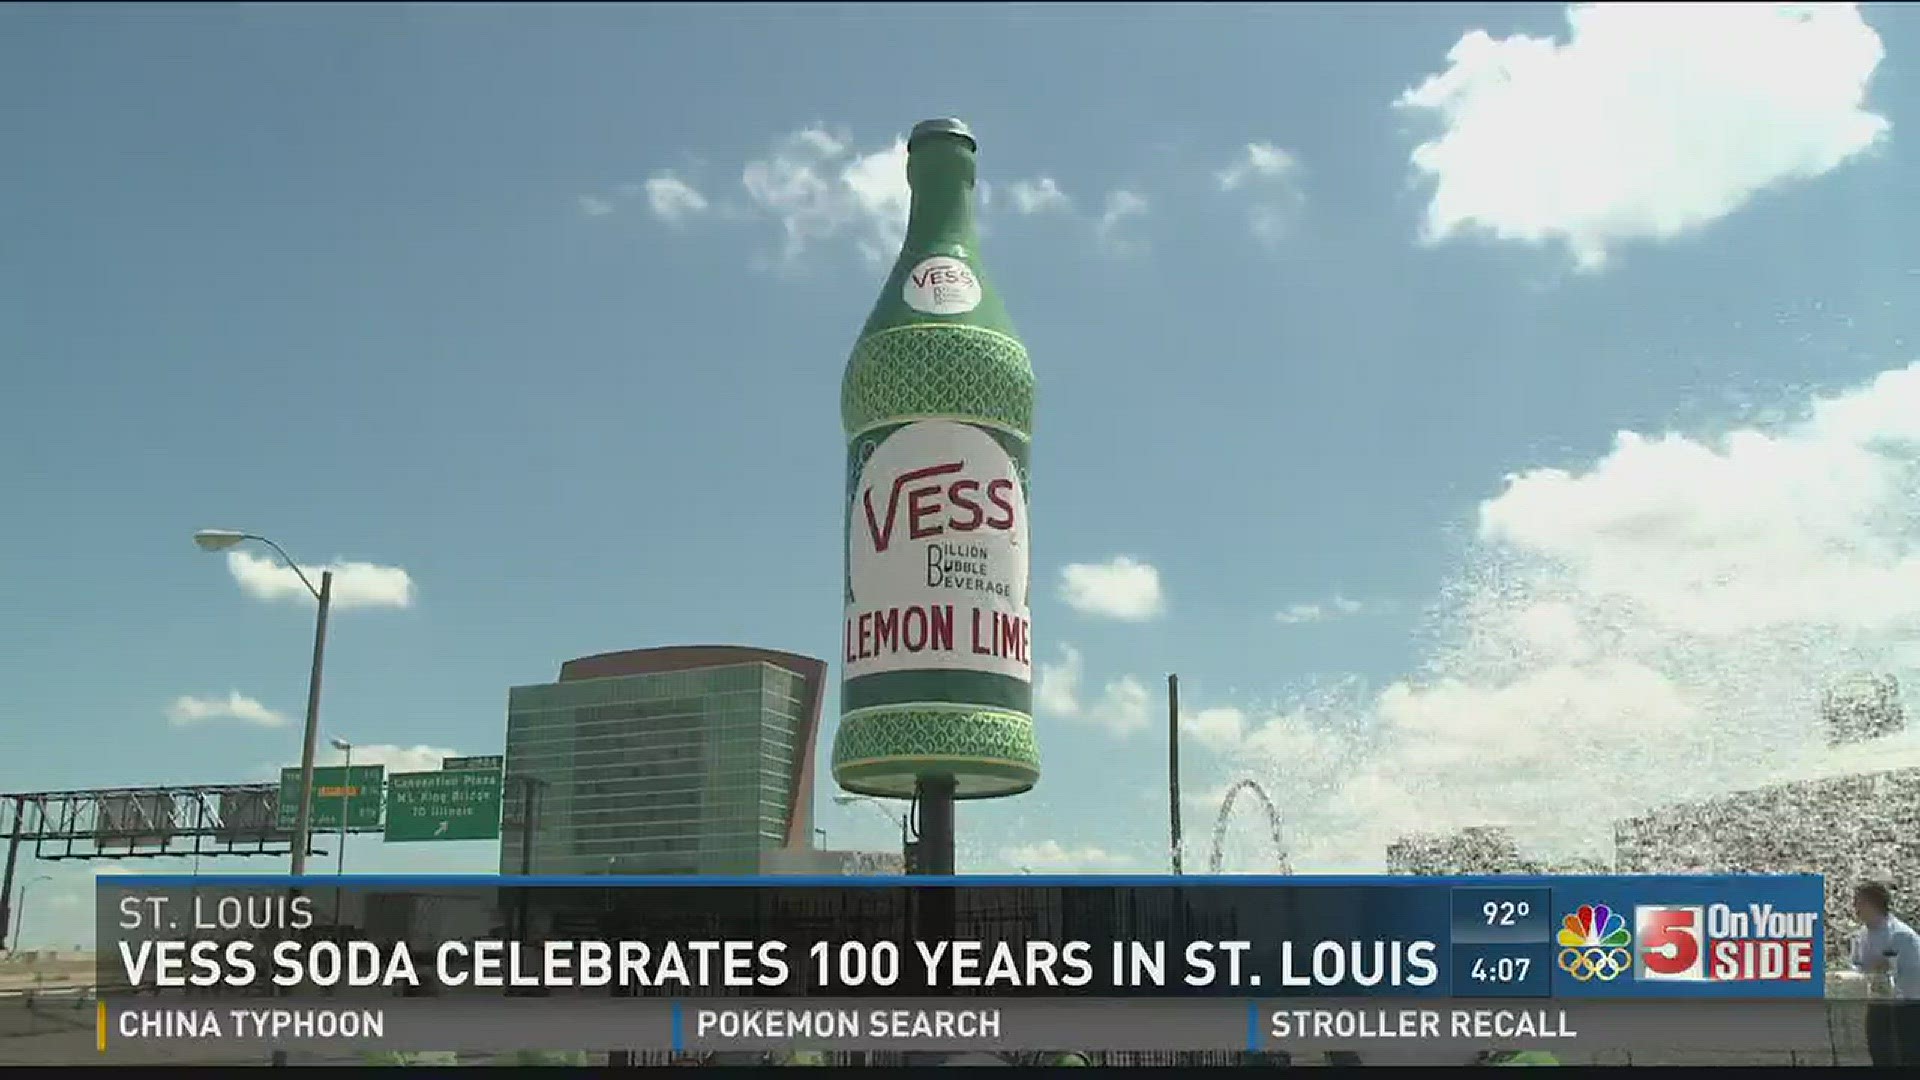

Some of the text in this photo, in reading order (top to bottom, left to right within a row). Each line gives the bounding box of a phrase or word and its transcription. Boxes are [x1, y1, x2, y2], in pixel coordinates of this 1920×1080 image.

[912, 265, 974, 288] VESS
[863, 460, 1015, 554] VESS
[846, 604, 1030, 666] LEMON LIME
